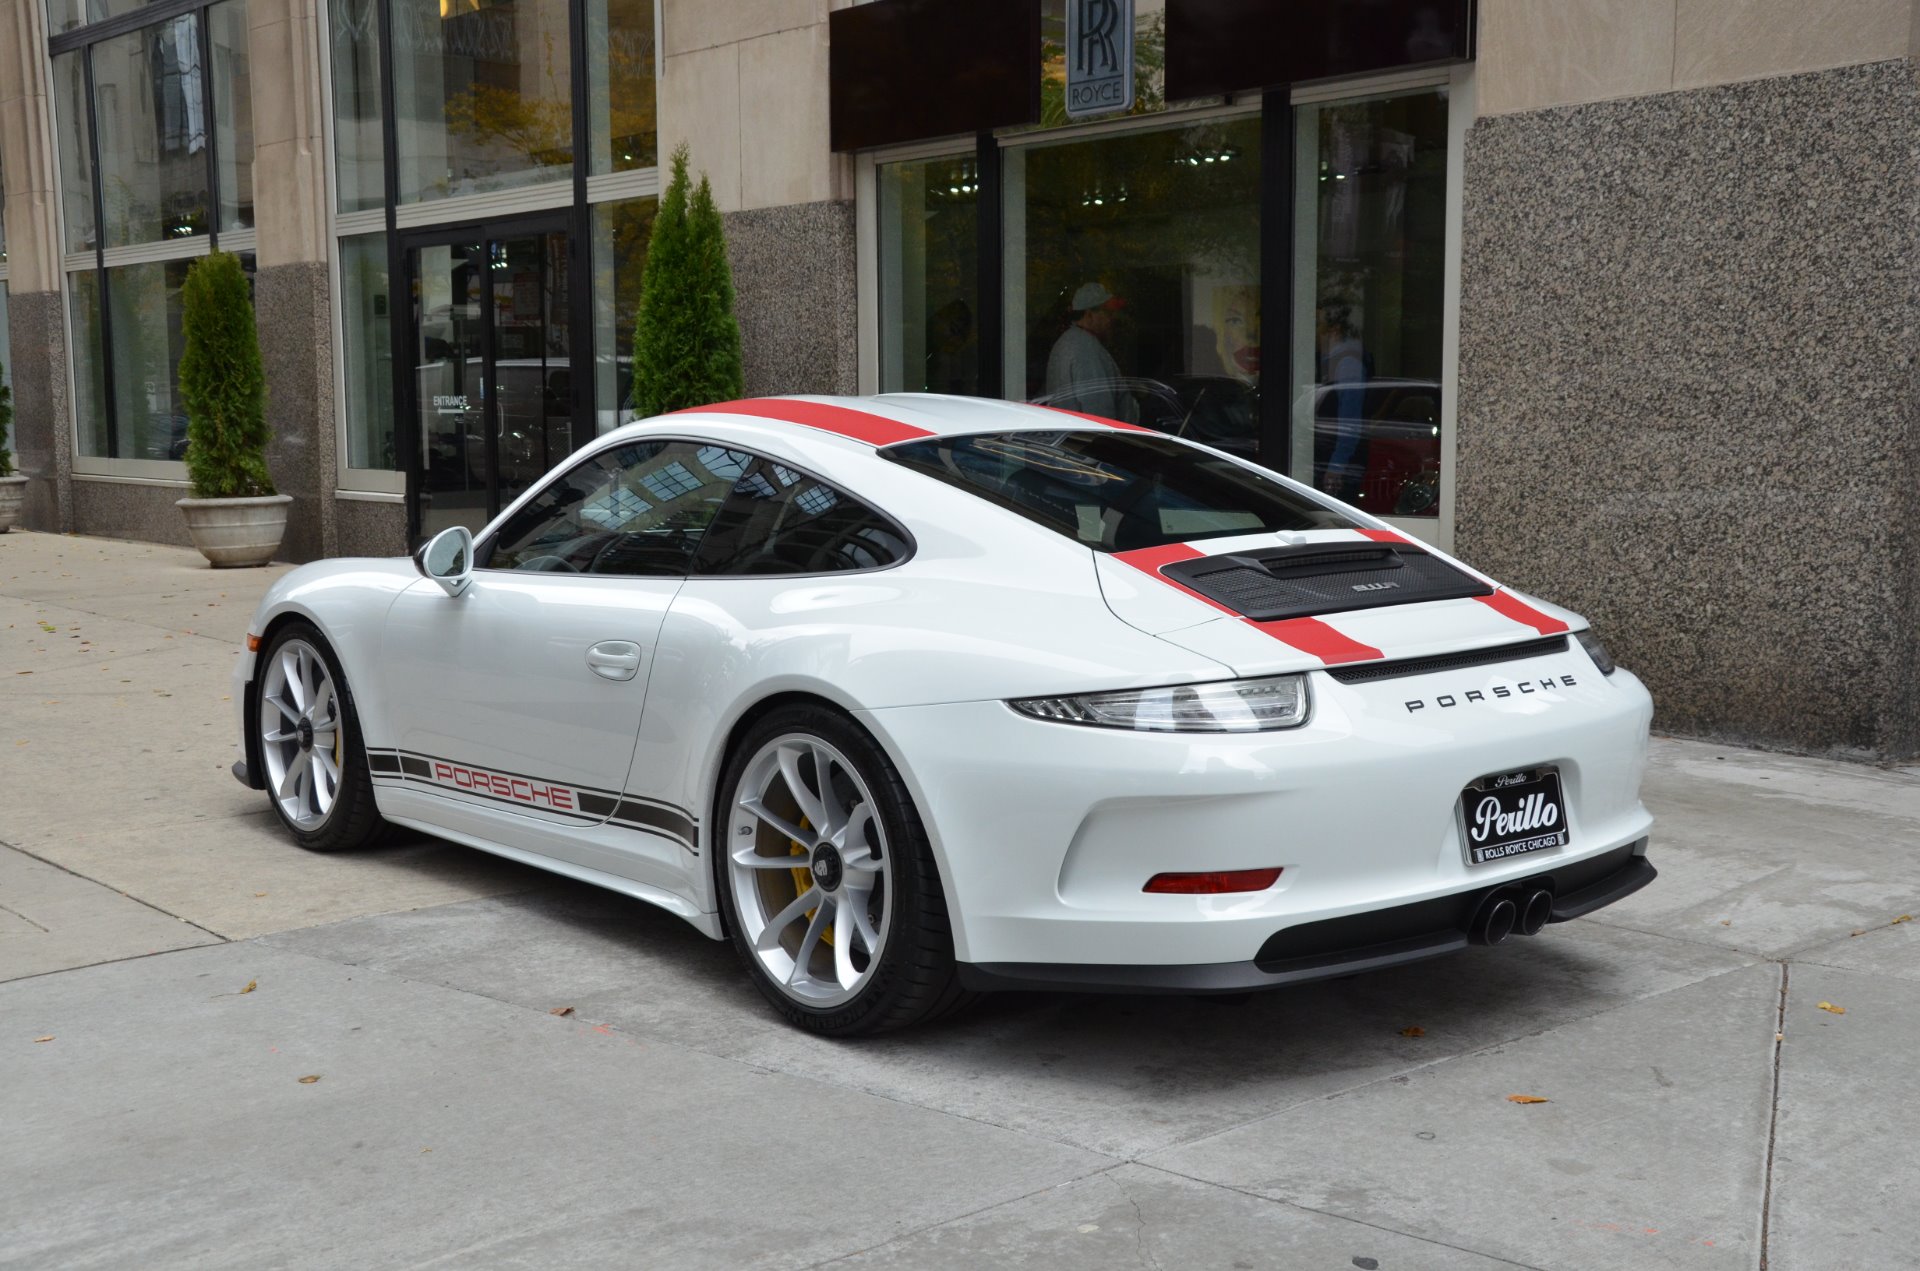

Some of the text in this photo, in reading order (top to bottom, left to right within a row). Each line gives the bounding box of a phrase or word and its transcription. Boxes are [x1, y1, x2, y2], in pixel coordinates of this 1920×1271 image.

[1072, 81, 1121, 105] ROYCE
[433, 395, 468, 406] ENTRANCE
[1404, 674, 1577, 713] PORSCHE
[435, 763, 573, 809] PORSCHE
[1495, 772, 1527, 788] Perillo
[1471, 792, 1558, 841] Perillo
[1485, 846, 1505, 859] ROLLS
[1506, 842, 1527, 855] ROYCE
[1528, 836, 1557, 850] CHICAGO
